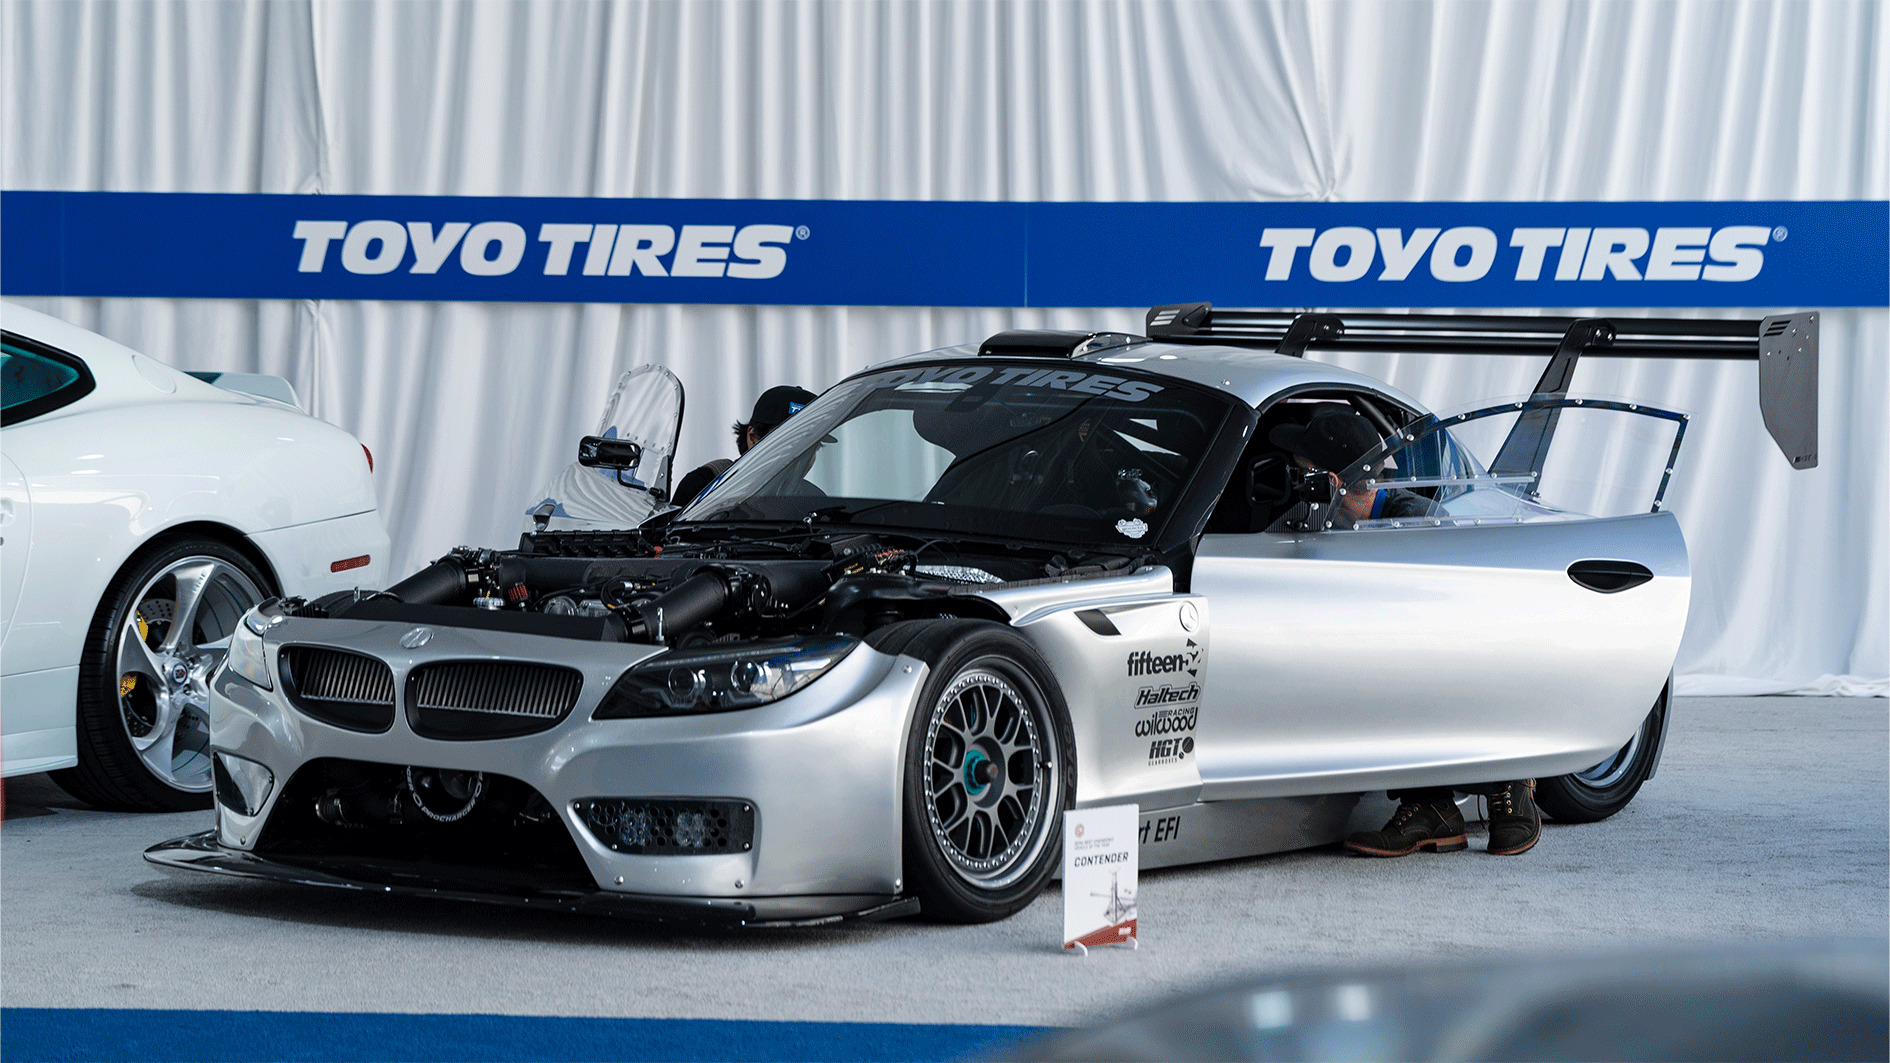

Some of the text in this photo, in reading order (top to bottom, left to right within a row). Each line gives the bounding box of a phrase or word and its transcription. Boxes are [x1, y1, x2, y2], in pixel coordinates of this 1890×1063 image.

[293, 220, 526, 276] TOYO
[1259, 226, 1498, 282] TOYO
[989, 367, 1165, 402] TIRES
[1136, 683, 1199, 707] Haltech
[1135, 706, 1198, 738] wilwood
[1168, 707, 1195, 717] RACING
[1149, 737, 1182, 760] HGT
[1154, 816, 1181, 842] EFI
[1074, 851, 1129, 868] CONTENDER
